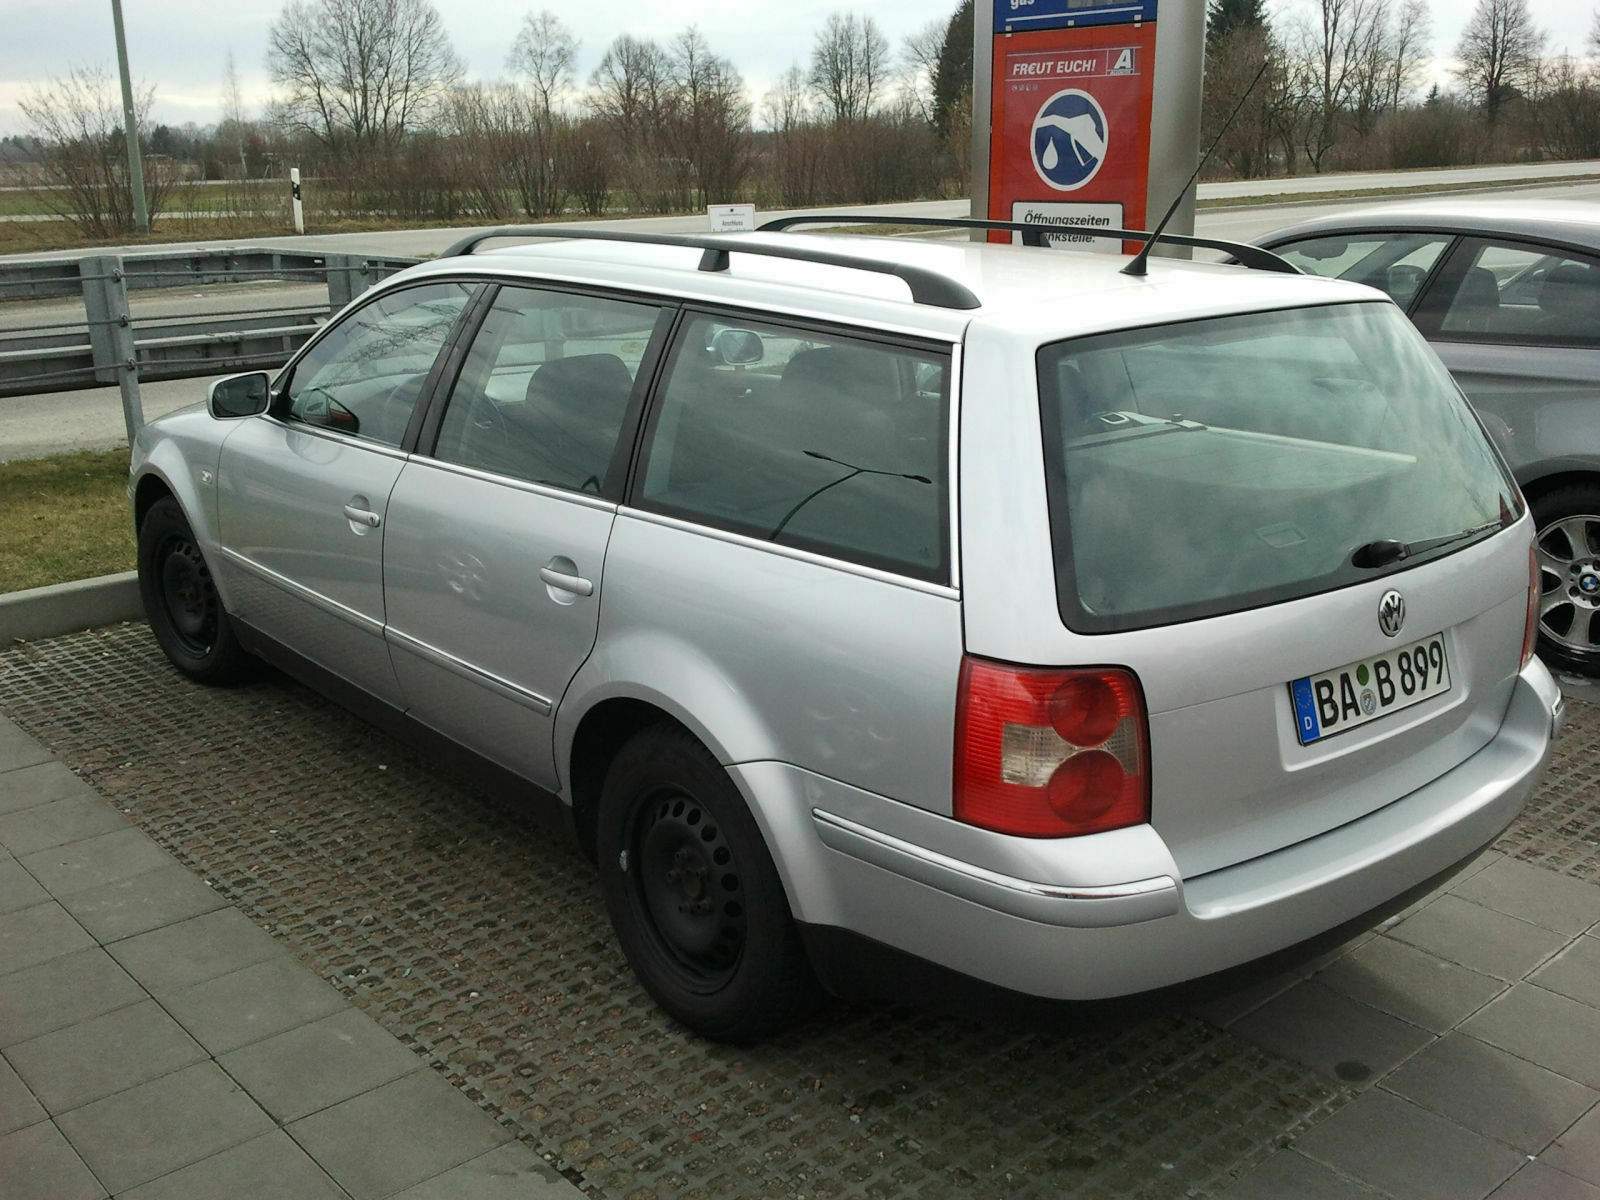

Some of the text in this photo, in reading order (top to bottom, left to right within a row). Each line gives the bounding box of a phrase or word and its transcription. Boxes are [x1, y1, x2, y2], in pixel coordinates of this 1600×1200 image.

[1056, 59, 1097, 73] EUCH!
[1024, 209, 1110, 226] Öffnungszeiten
[1304, 640, 1444, 731] D BA B 899
